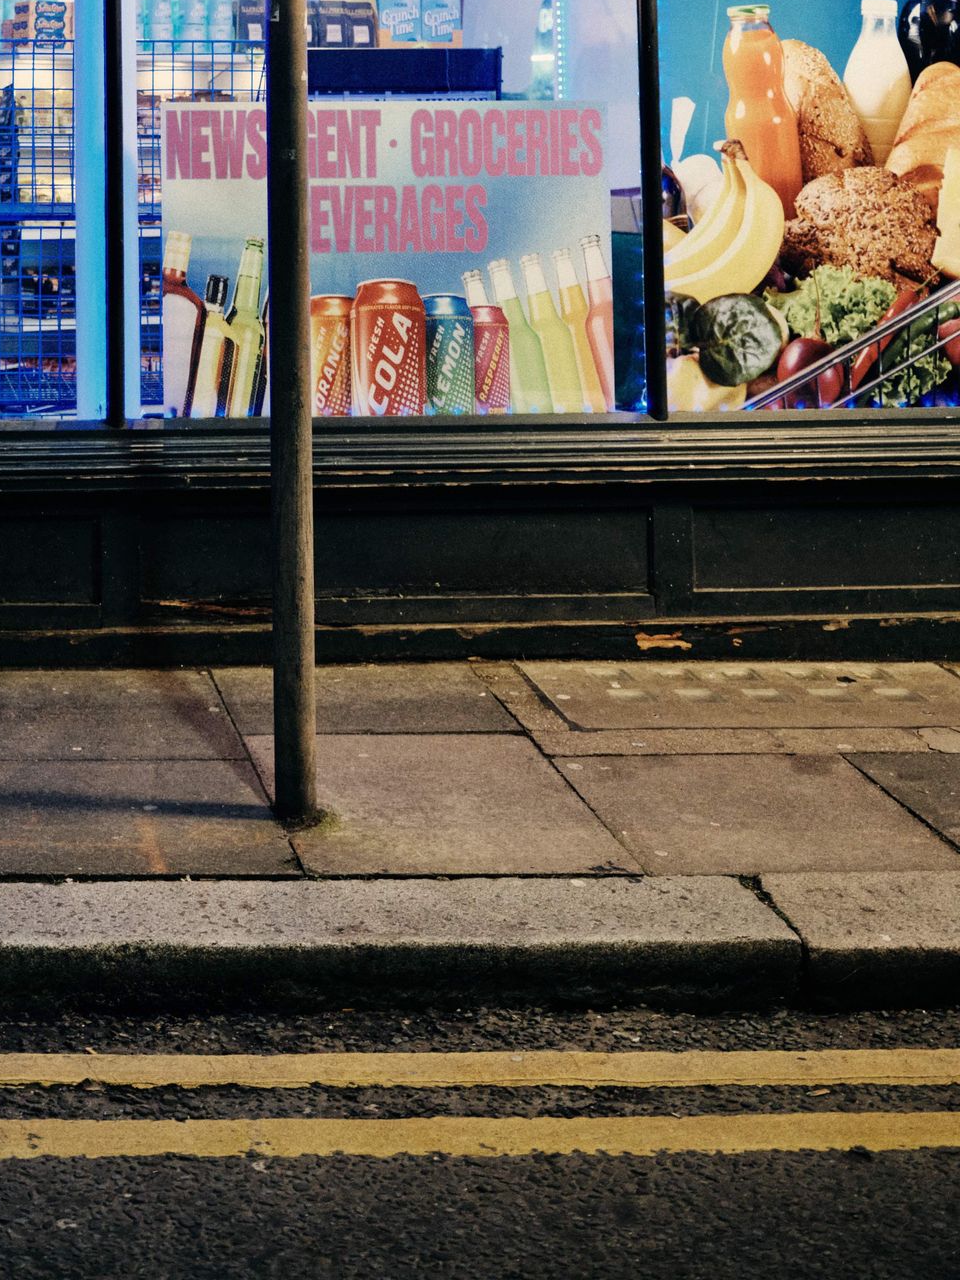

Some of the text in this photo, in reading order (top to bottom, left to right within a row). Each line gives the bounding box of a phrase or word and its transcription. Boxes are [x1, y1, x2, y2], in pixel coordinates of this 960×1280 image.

[381, 5, 419, 25] Crunch
[390, 22, 414, 36] Time
[424, 6, 459, 27] Crunch
[431, 22, 454, 37] Time
[166, 109, 604, 180] NEWSENT GROCERIES
[310, 185, 488, 254] EVERAGES
[367, 316, 385, 362] FRESH
[429, 324, 445, 364] FRESH
[475, 331, 491, 363] FRESH
[315, 322, 349, 409] ORANGE
[368, 311, 413, 416] COLA
[432, 322, 466, 408] LEMON
[479, 328, 505, 402] RASPBERRY
